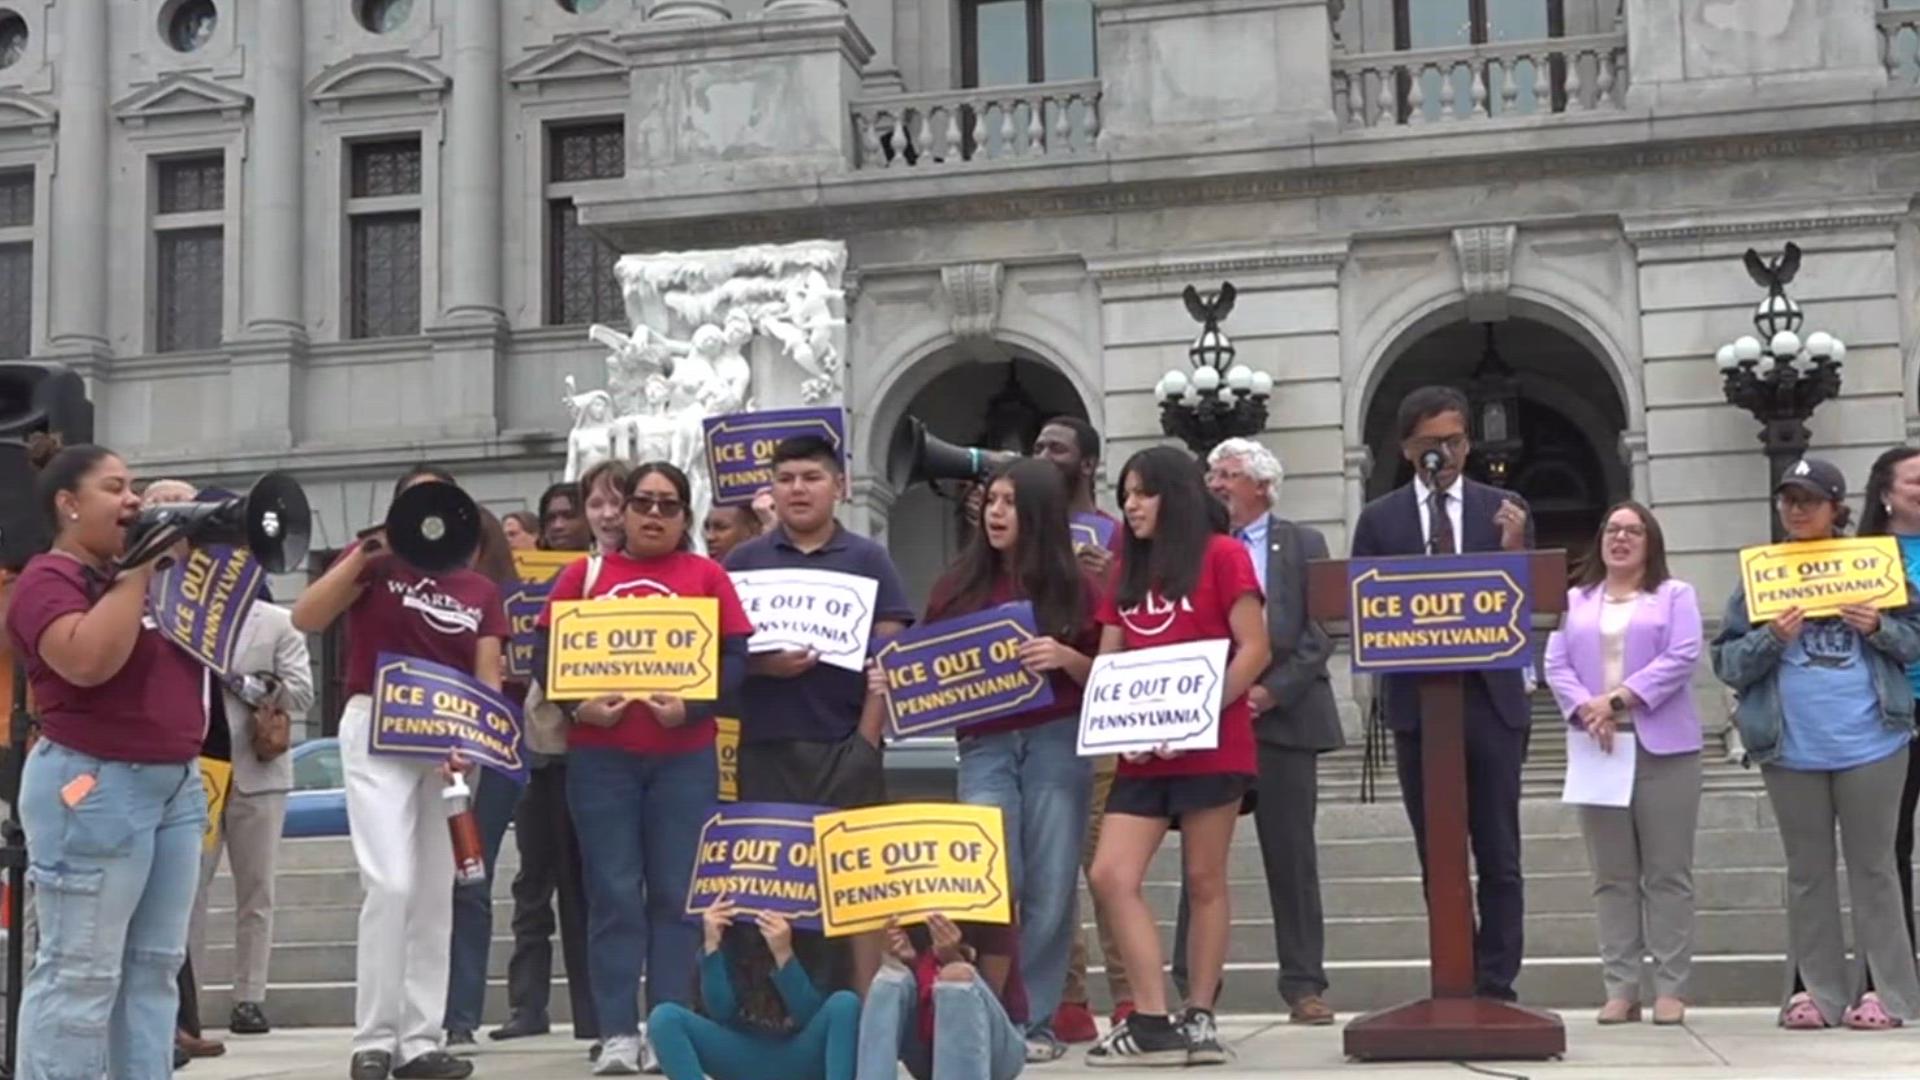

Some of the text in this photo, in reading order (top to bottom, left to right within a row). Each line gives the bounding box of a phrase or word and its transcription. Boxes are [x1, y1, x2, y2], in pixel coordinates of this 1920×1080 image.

[715, 442, 746, 463] ICE
[1753, 557, 1880, 583] ICE OUT OF
[174, 548, 212, 642] ICE OUT
[1758, 577, 1885, 602] PENNSYLVANIA
[770, 594, 816, 610] OUT
[826, 599, 852, 617] OF
[1362, 590, 1507, 618] ICE OUT OF
[562, 629, 697, 650] ICE OUT OF
[1363, 626, 1510, 648] PENNSYLVANIA
[560, 661, 697, 677] PENNSYLVANIA
[889, 637, 1021, 689] ICE OUT OF
[896, 670, 1030, 717] PENNSYLVANIA
[1093, 675, 1205, 703] ICE OUT OF
[384, 684, 511, 735] ICE OUT OF
[1089, 708, 1201, 731] PENNSYLVANIA
[382, 717, 512, 760] PENNSYLVANIA
[701, 841, 728, 864] ICE
[732, 839, 781, 863] OUT
[830, 841, 982, 875] ICE OUT OF
[833, 877, 987, 908] PENNSYLVANIA
